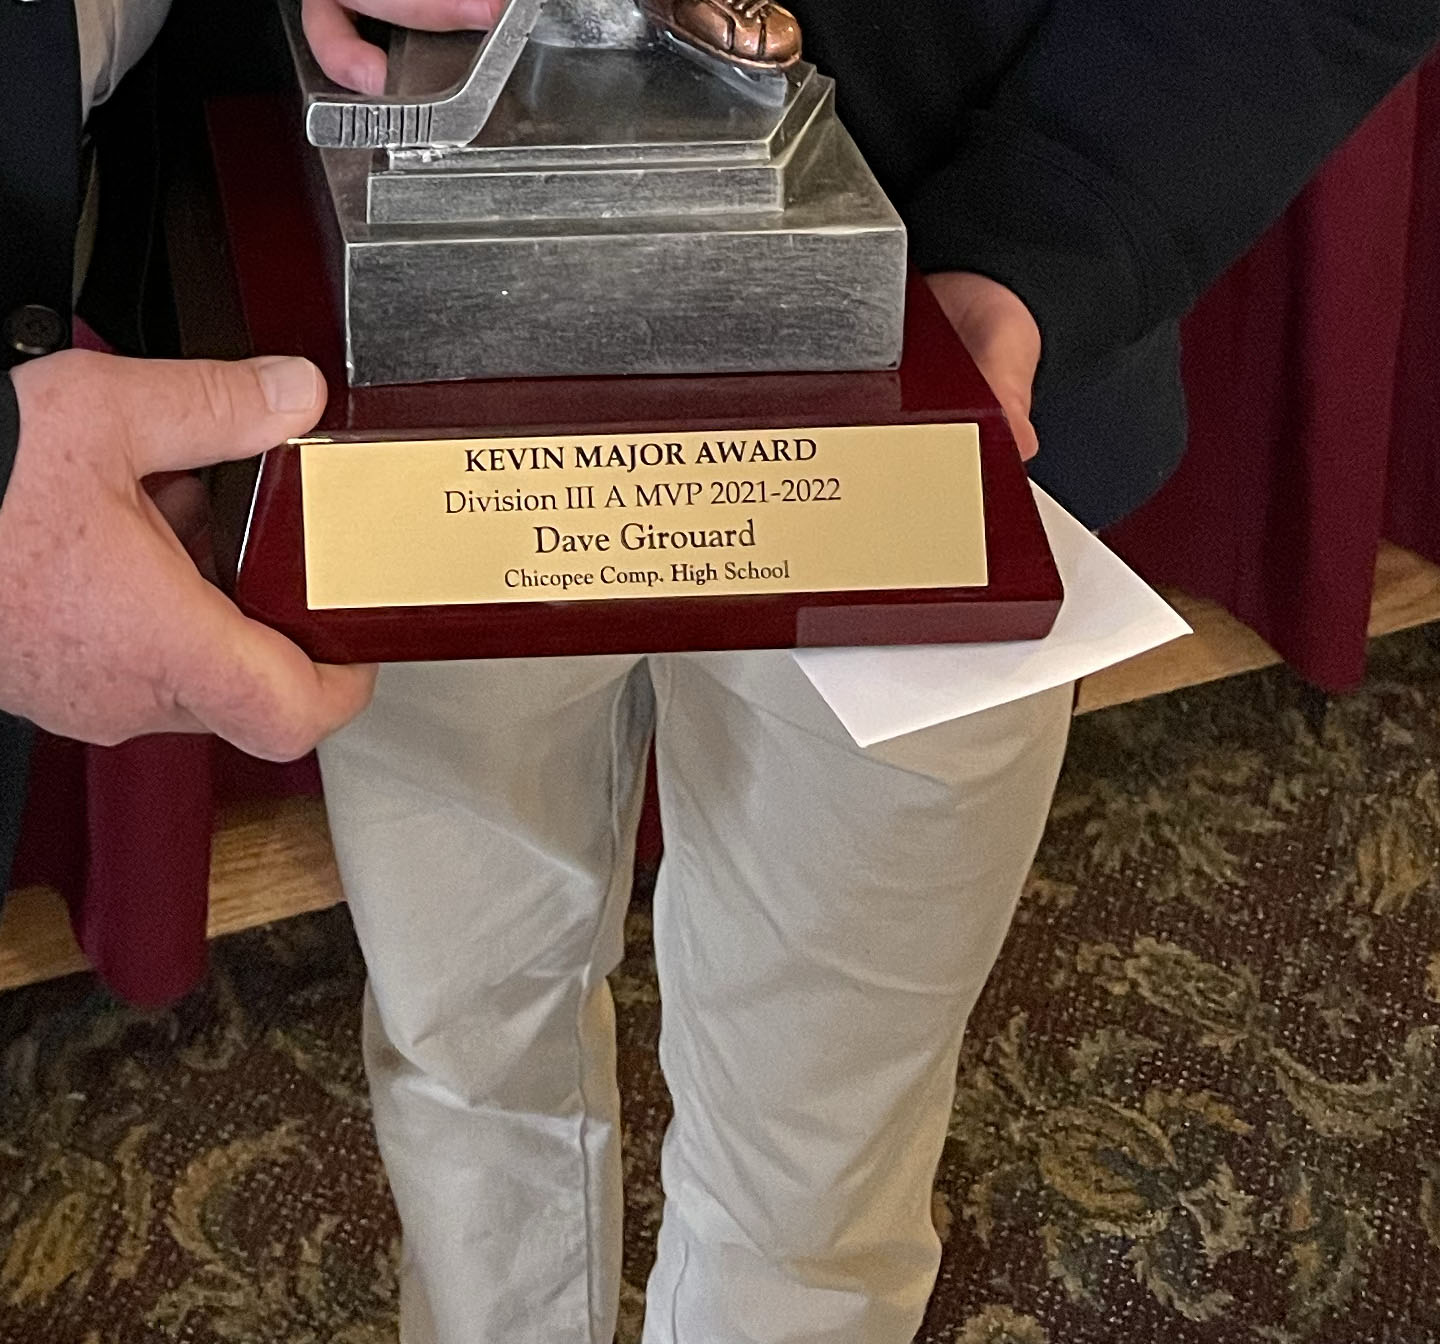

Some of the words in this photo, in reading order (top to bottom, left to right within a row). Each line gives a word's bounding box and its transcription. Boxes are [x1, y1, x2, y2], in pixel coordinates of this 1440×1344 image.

[464, 446, 564, 472] KEVIN
[574, 442, 686, 473] MAJOR
[694, 438, 817, 464] AWARD
[444, 488, 558, 514] Division
[565, 485, 596, 510] III
[604, 485, 627, 508] A
[635, 482, 703, 507] MVP
[710, 477, 842, 505] 2021-2022
[532, 526, 610, 554] Dave
[620, 518, 756, 551] Girouard
[504, 568, 594, 591] Chicopee
[600, 565, 664, 587] Comp.
[670, 562, 719, 585] High
[724, 559, 790, 580] School
